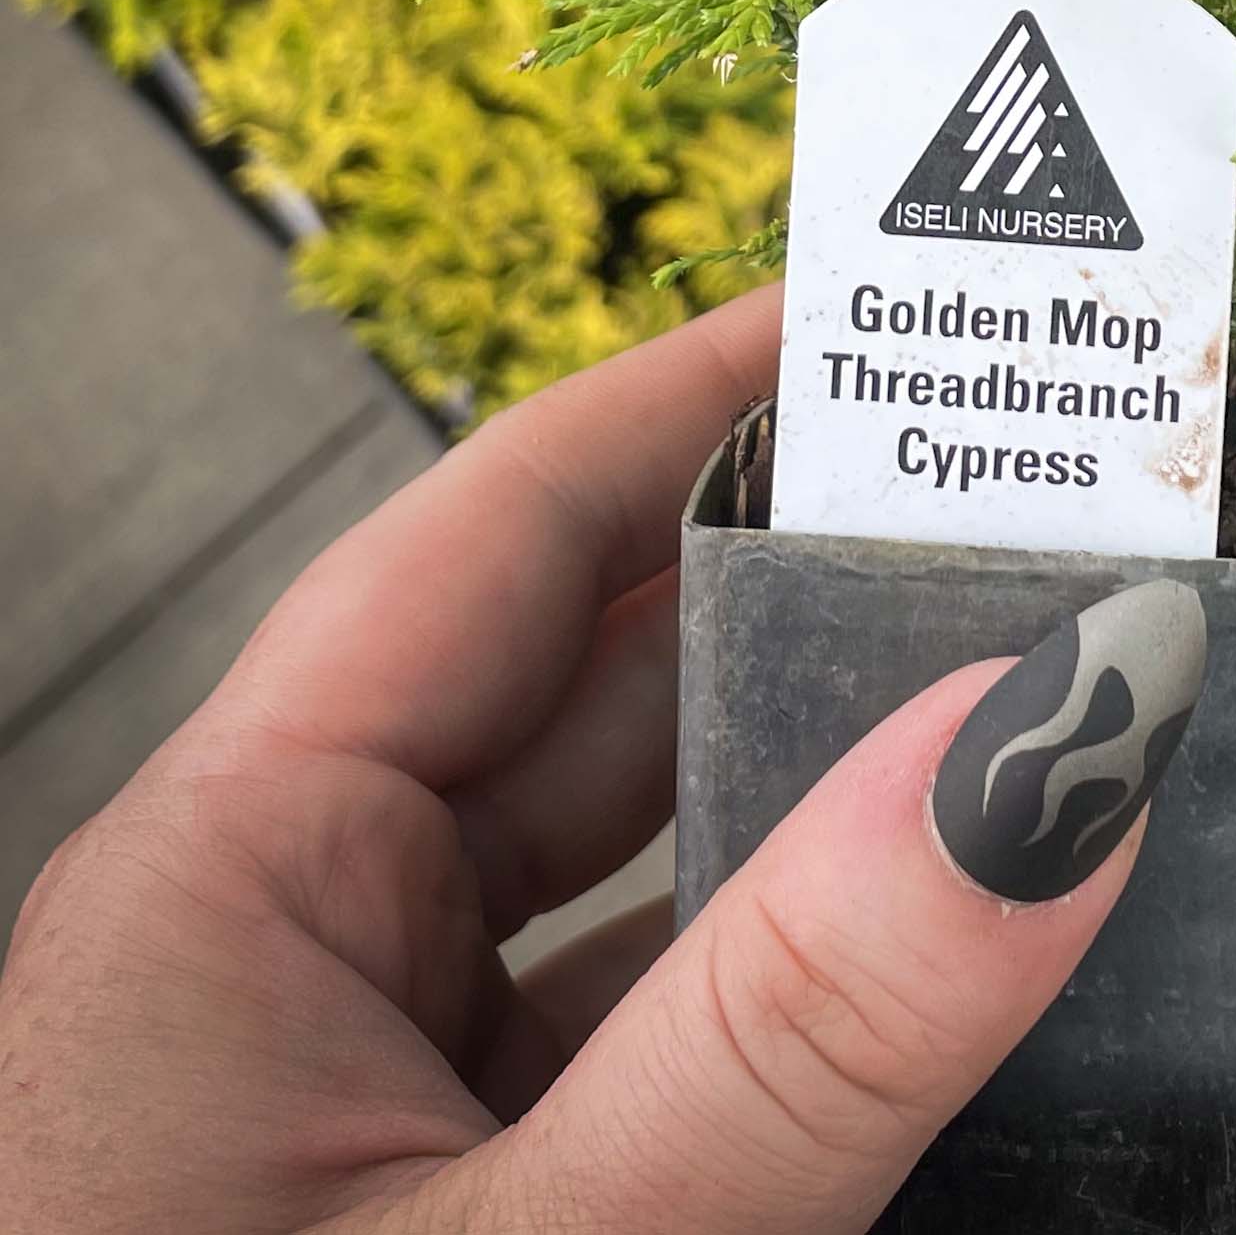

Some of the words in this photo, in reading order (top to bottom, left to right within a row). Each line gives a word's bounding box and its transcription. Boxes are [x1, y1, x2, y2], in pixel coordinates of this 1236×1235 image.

[895, 202, 968, 233] ISELI
[977, 207, 1128, 243] NURSERY
[850, 284, 1030, 343] Golden
[1049, 298, 1163, 364] Mop
[822, 352, 1182, 423] Threadbranch
[897, 426, 1100, 493] Cypress
